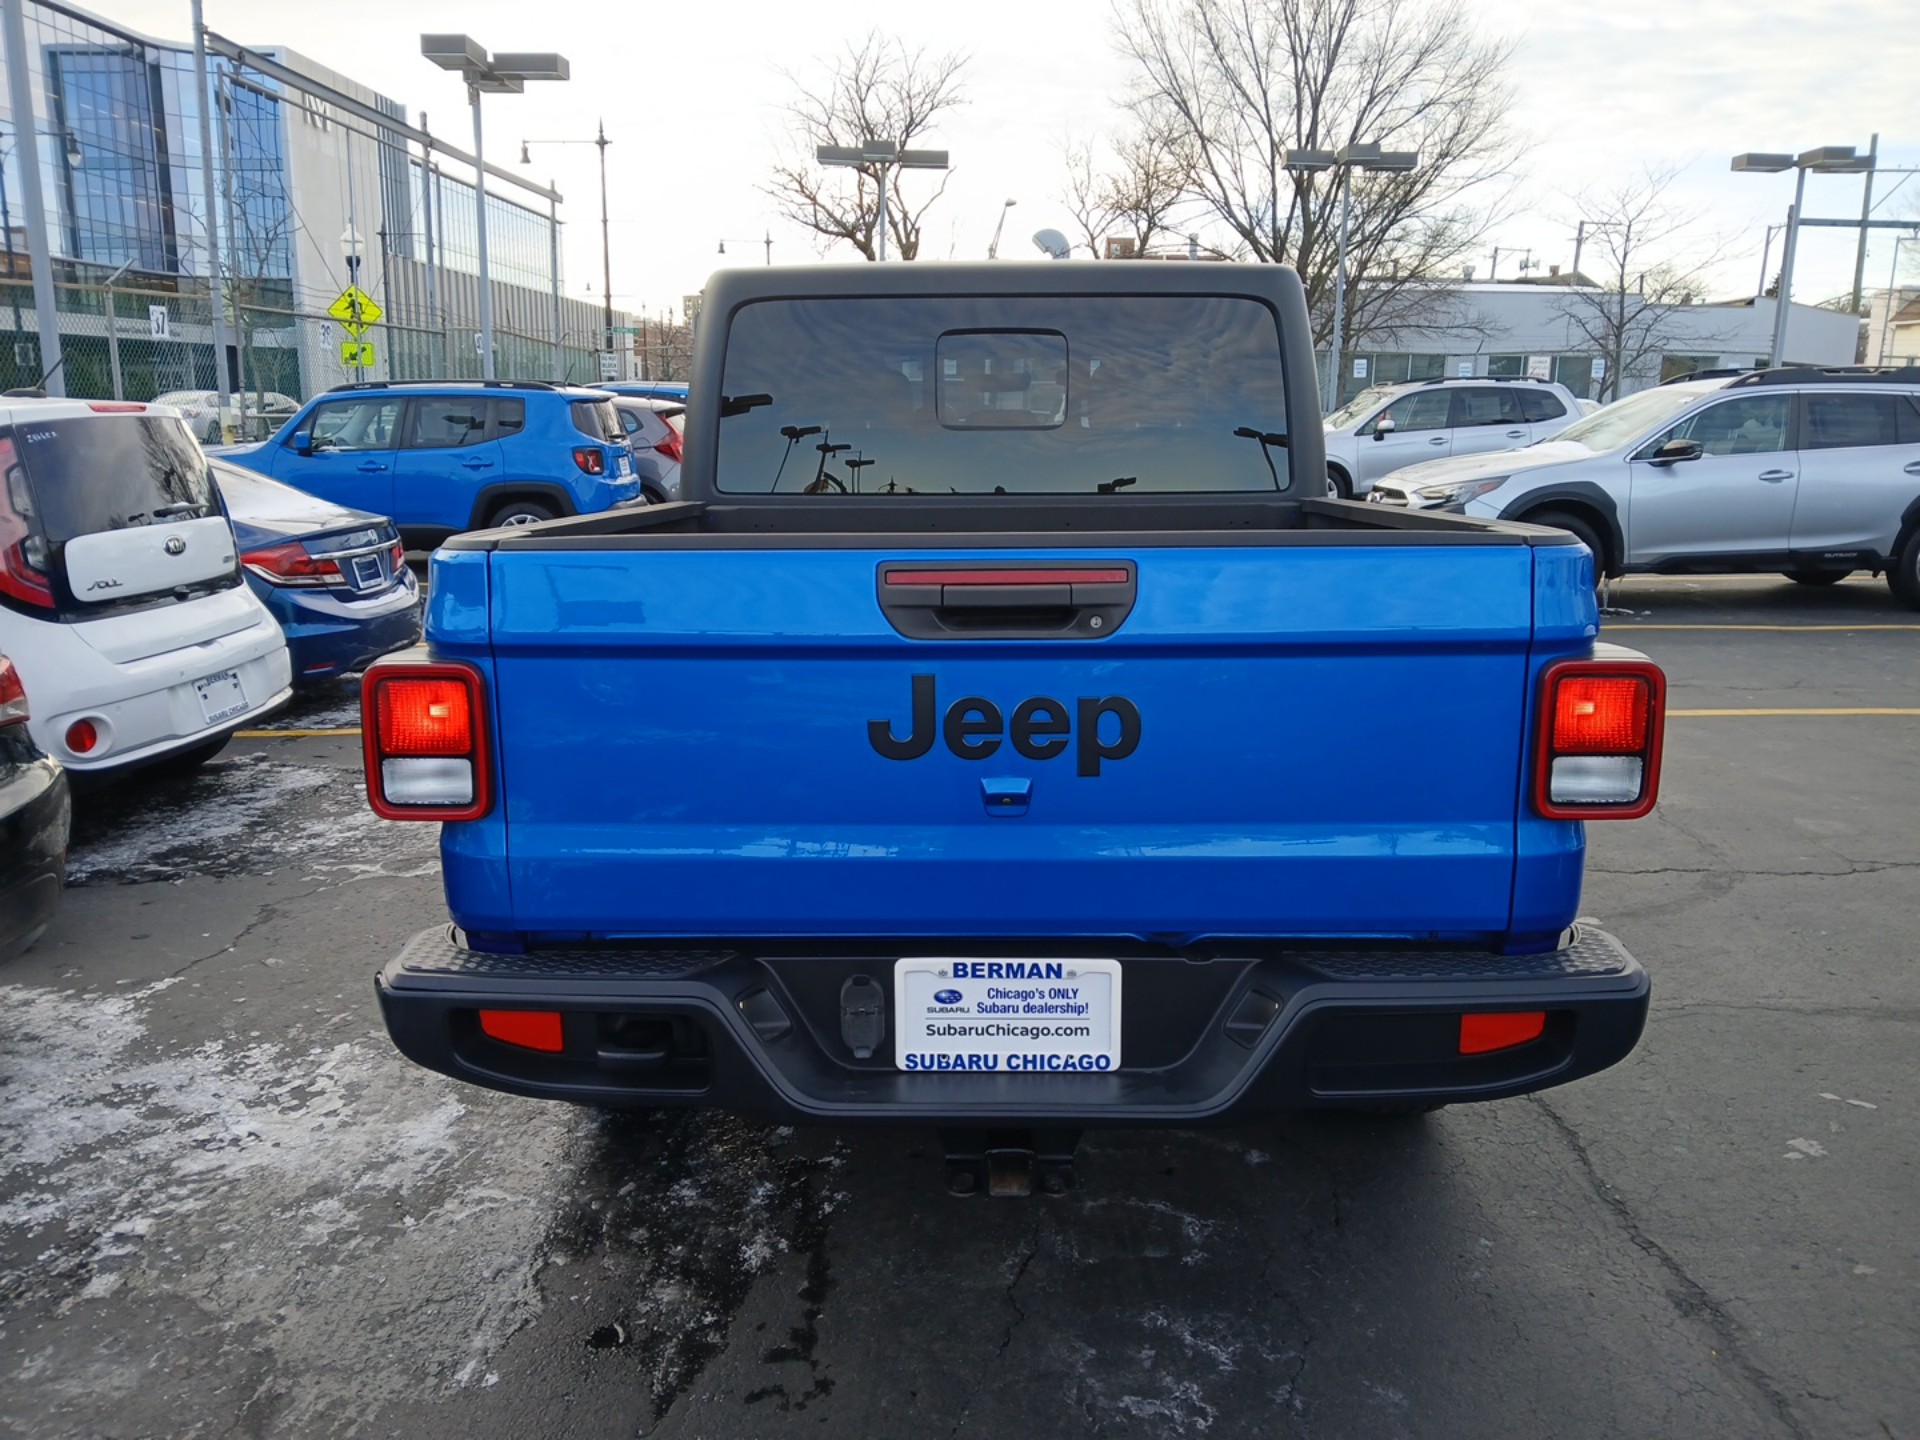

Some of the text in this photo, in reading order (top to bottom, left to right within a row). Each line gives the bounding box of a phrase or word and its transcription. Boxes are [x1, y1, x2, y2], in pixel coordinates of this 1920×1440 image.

[867, 673, 1141, 777] Jeep
[953, 962, 1062, 979] BERMAN
[987, 987, 1079, 1002] Chicago's ONLY
[976, 1002, 1089, 1016] Subaru dealership!
[926, 1024, 1090, 1040] SubaruChicago.com
[905, 1053, 1111, 1070] SUBARU CHICAGO
